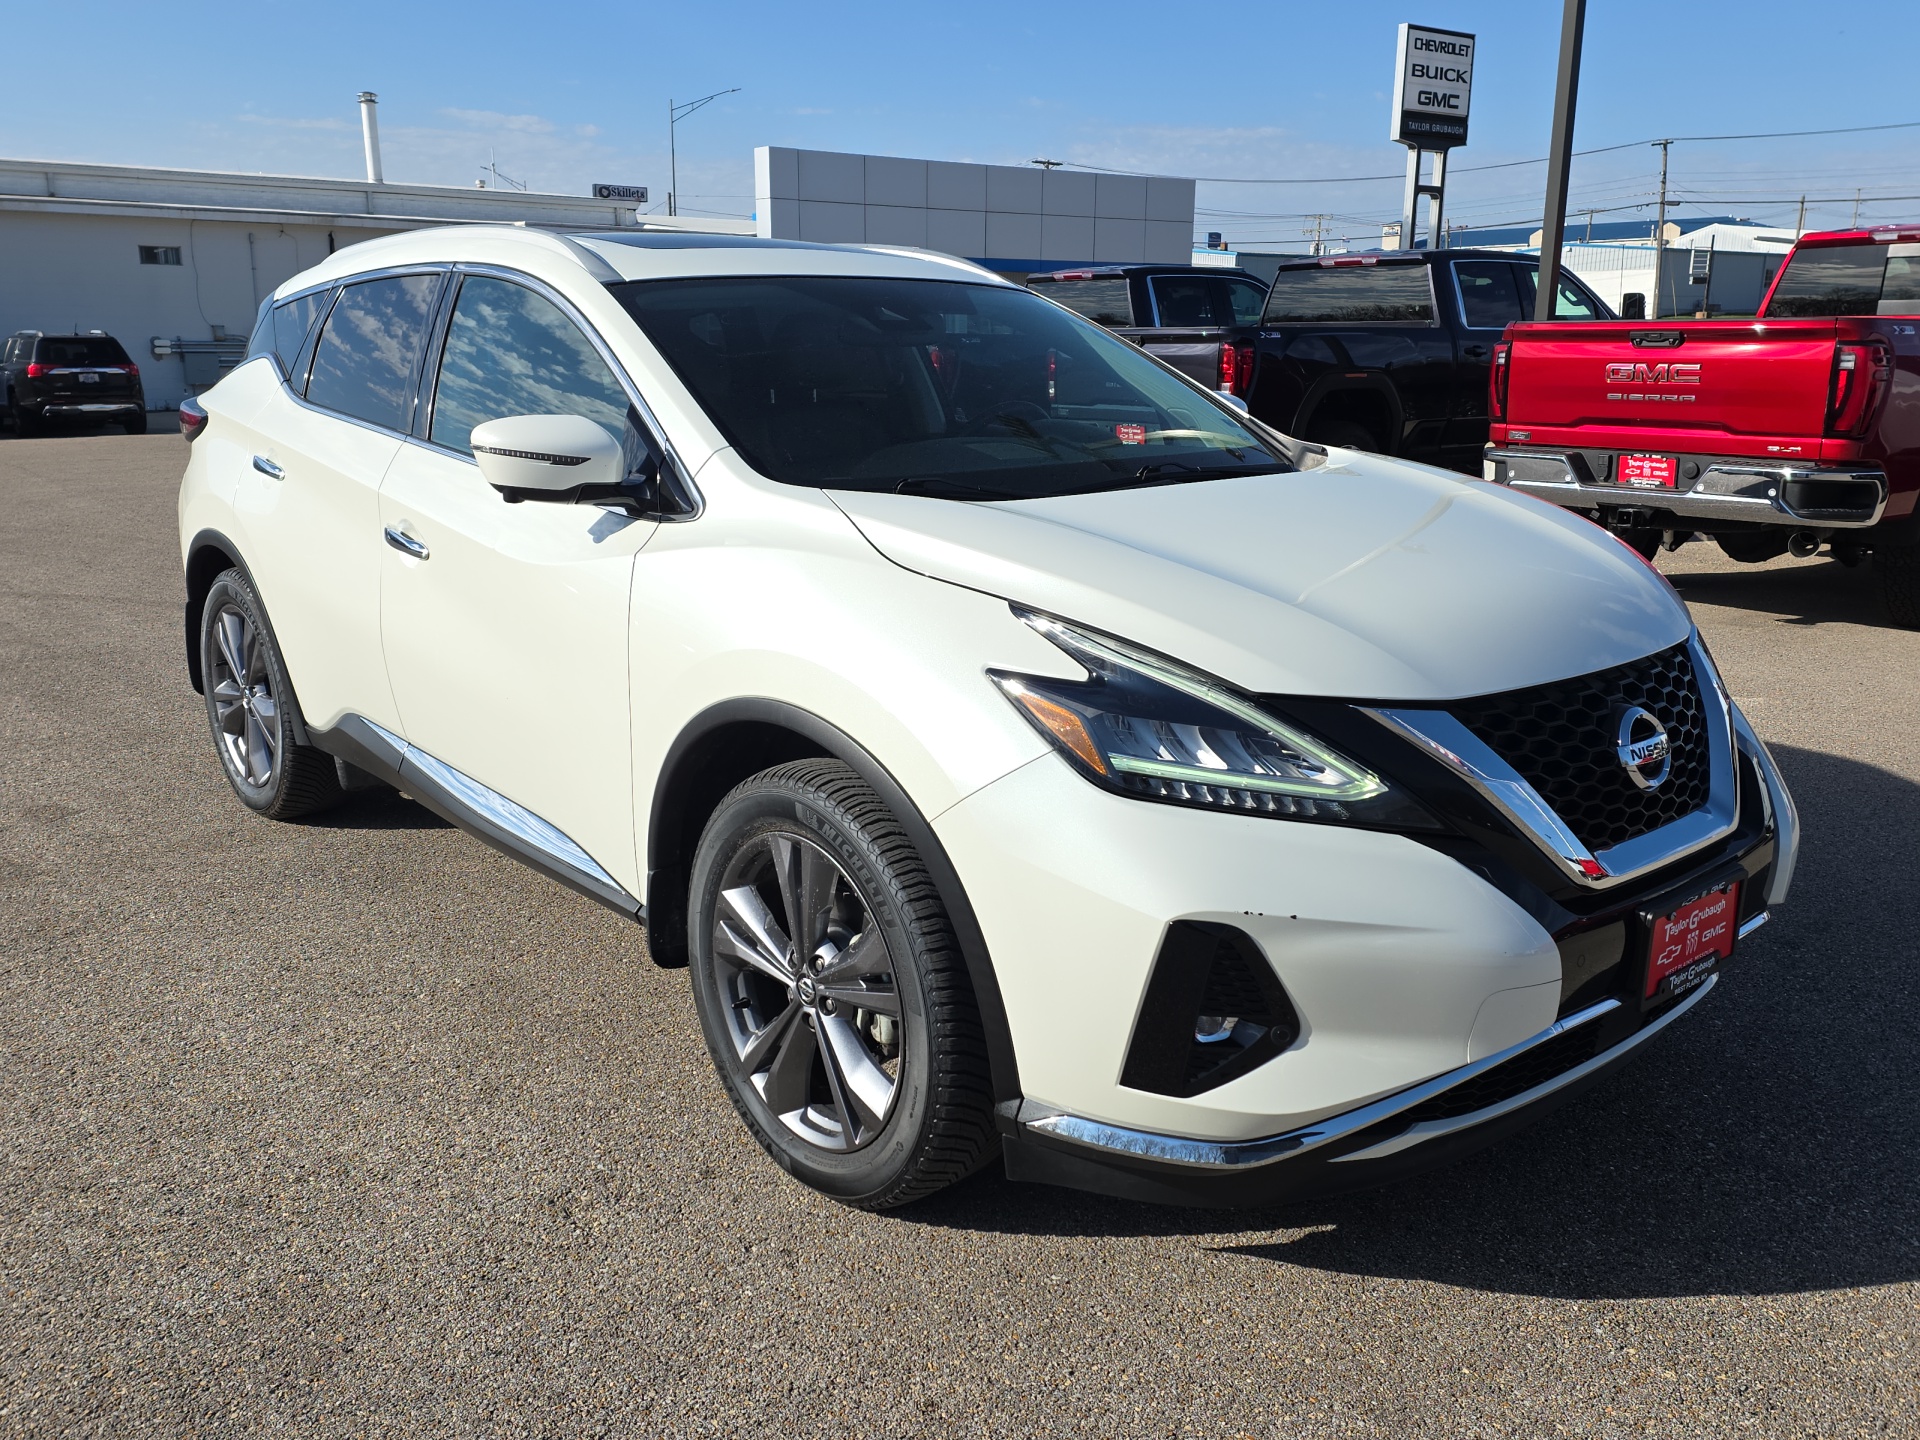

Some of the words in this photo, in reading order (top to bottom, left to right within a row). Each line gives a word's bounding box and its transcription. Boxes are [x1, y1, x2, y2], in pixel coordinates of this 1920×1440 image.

[1414, 37, 1470, 57] CHEVROLET
[1411, 63, 1469, 84] BUICK
[1417, 90, 1460, 109] GMC
[1408, 121, 1430, 132] TAYLOR
[1431, 123, 1464, 135] GRUBAUGH
[611, 187, 645, 198] Skillets
[1605, 363, 1702, 384] GMC
[1606, 393, 1696, 403] SIERRA
[1629, 737, 1671, 762] NISS
[821, 823, 894, 925] MICHELIN
[1664, 918, 1689, 942] Taylor
[1689, 899, 1726, 930] Grubaugh
[1701, 922, 1727, 942] GMC
[1669, 971, 1688, 990] Taylor
[1688, 956, 1715, 979] Grubaugh
